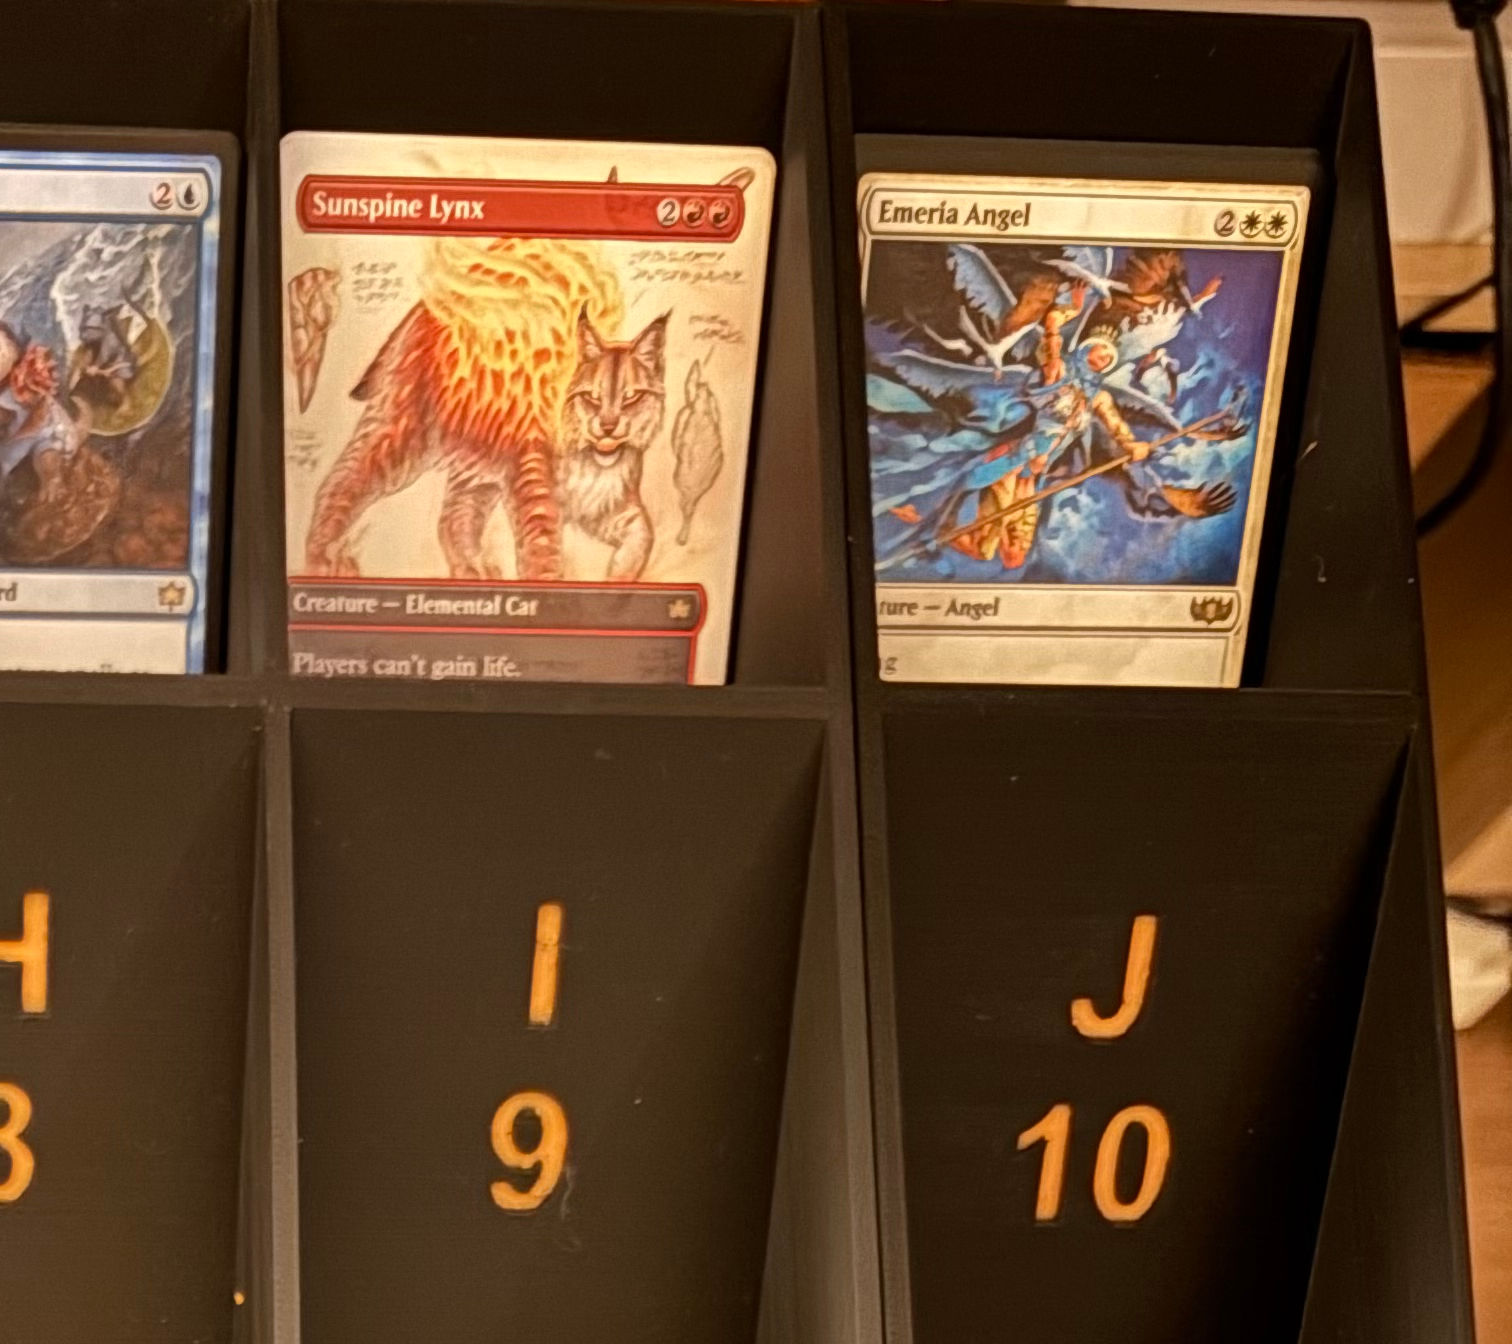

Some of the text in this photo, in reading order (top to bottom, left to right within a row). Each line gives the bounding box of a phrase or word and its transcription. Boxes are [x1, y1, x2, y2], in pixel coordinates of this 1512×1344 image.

[311, 191, 485, 222] Sunspine Lynx
[878, 200, 1031, 231] Emeria Angel
[293, 592, 378, 613] Creature
[405, 595, 501, 616] Elemental
[505, 597, 538, 616] Cat
[944, 598, 999, 621] Angel
[292, 653, 367, 677] Players
[431, 659, 476, 680] gain
[482, 657, 522, 678] life.
[528, 902, 564, 1026] I
[1070, 914, 1157, 1040] J
[490, 1090, 569, 1211] 9
[1016, 1103, 1171, 1222] 10
